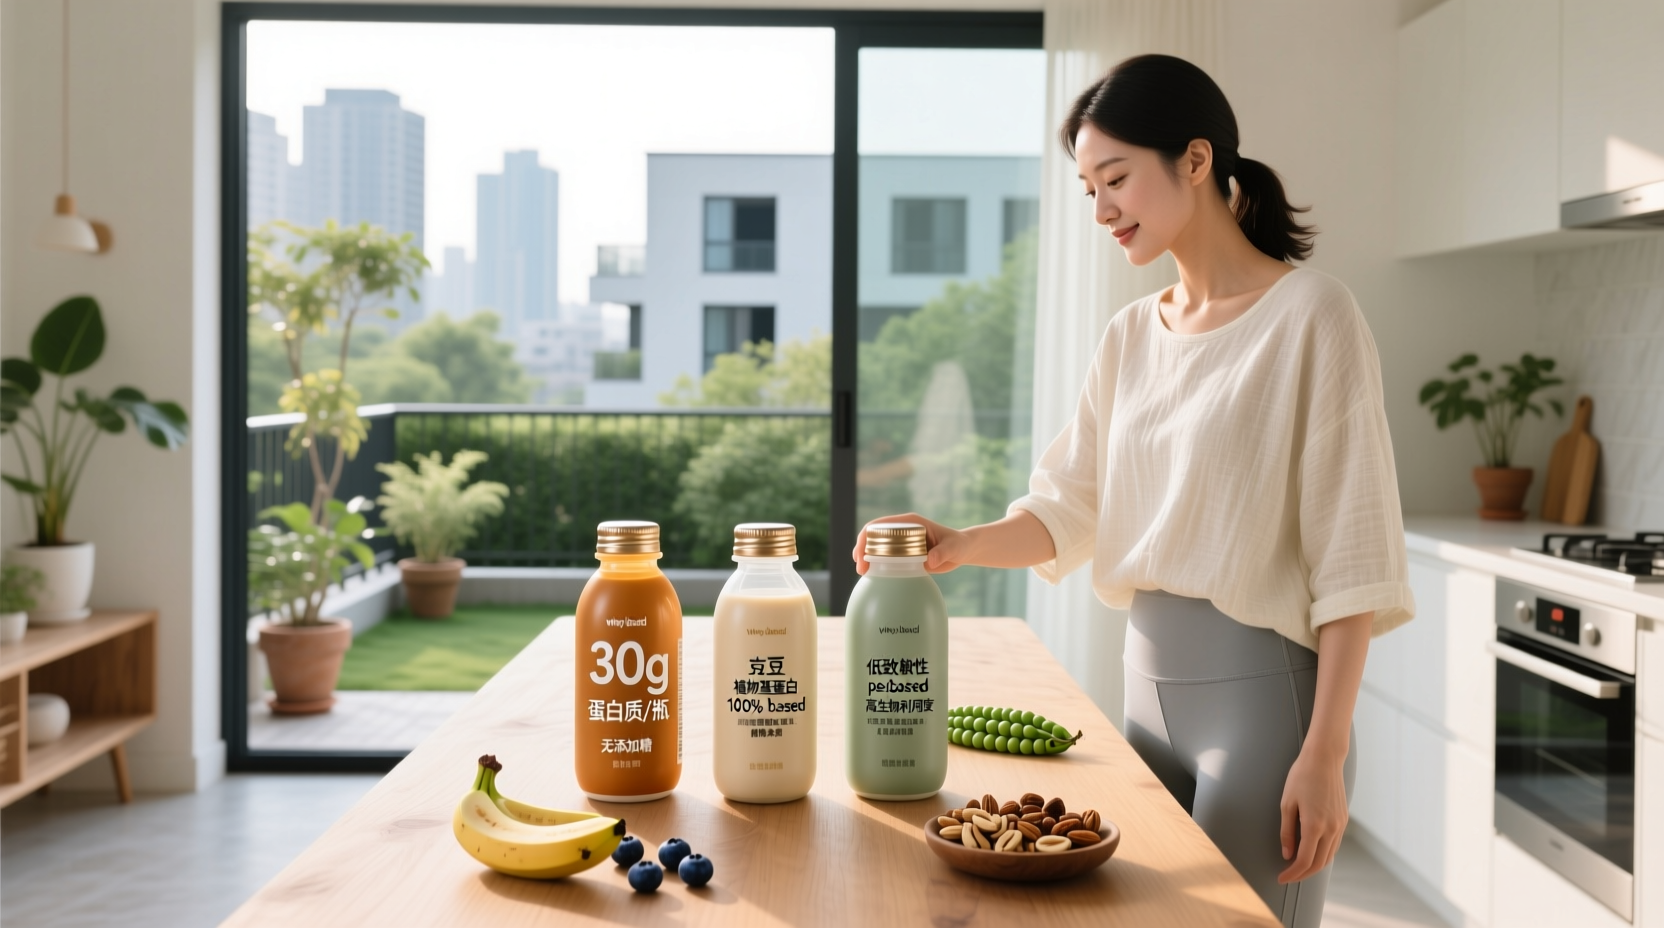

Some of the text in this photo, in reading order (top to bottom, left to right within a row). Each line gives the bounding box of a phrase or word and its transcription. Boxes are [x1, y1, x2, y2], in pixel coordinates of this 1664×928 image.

[589, 640, 669, 695] 30g
[727, 696, 806, 714] 100% based
